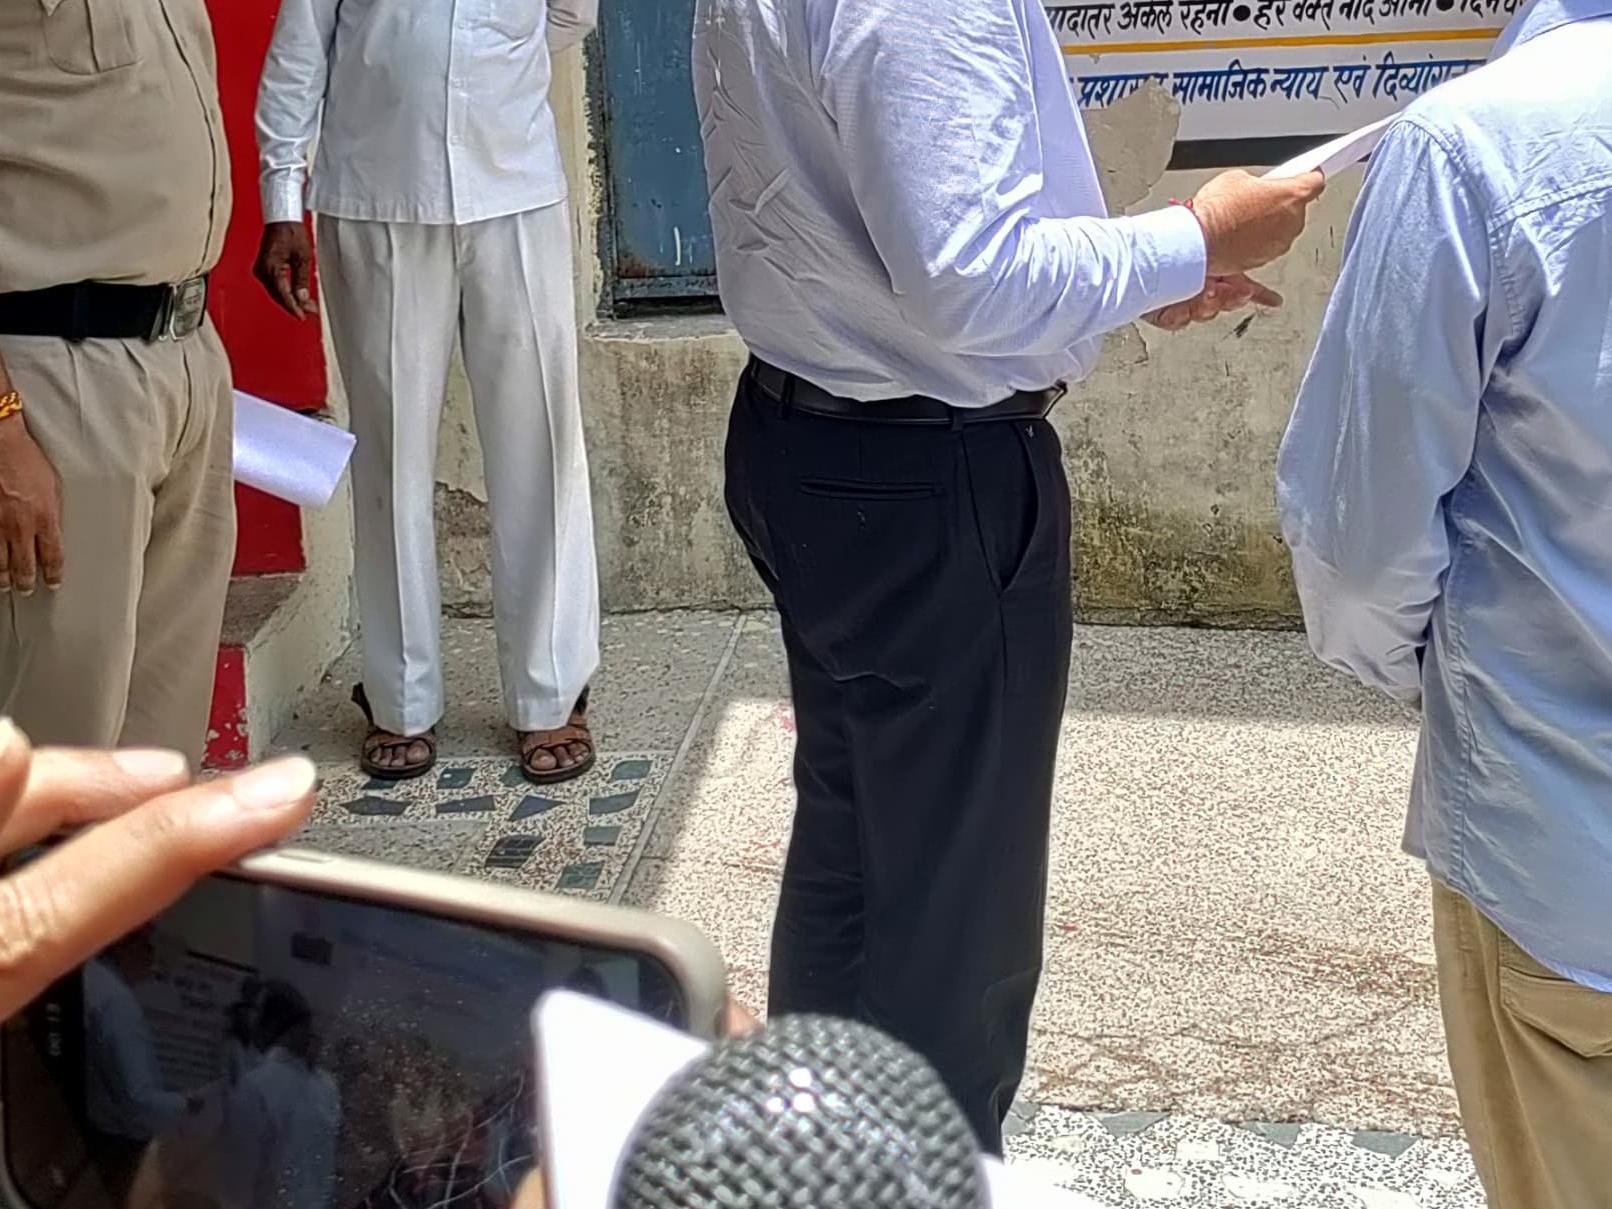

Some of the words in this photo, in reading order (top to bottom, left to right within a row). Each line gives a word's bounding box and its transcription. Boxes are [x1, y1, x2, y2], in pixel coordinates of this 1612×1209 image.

[1171, 58, 1270, 106] सामाजिक
[1270, 66, 1330, 101] न्याय
[1332, 56, 1372, 104] एवं
